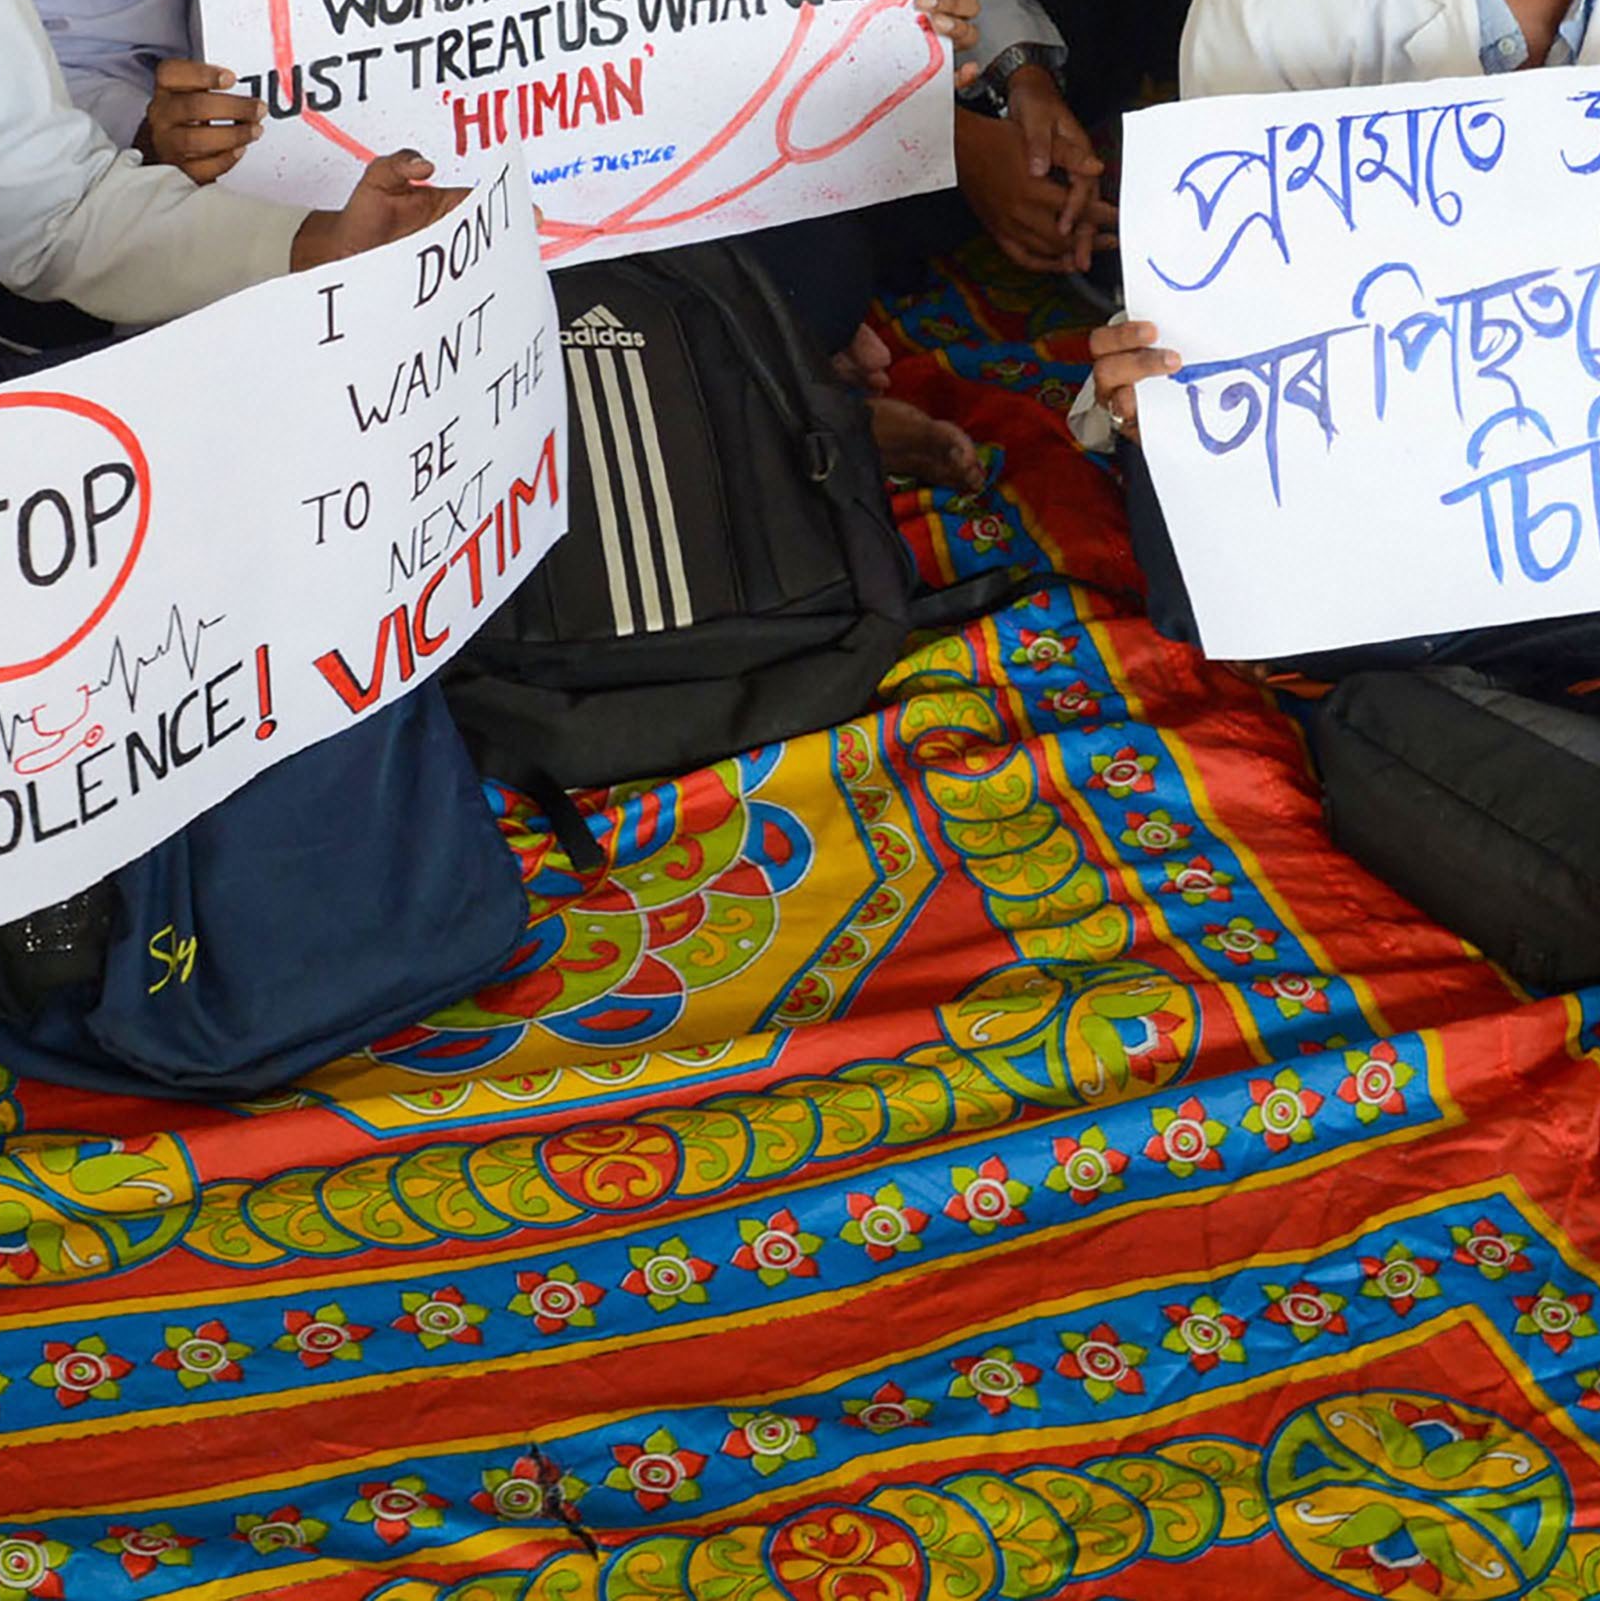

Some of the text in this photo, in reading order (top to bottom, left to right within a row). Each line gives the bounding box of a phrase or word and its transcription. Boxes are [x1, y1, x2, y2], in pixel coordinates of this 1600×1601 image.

[317, 283, 345, 346] I
[347, 292, 496, 434] WANT
[560, 327, 646, 348] adidas
[301, 326, 546, 545] TO BE THE
[312, 427, 560, 716] VICTIM
[385, 460, 494, 595] NEXT
